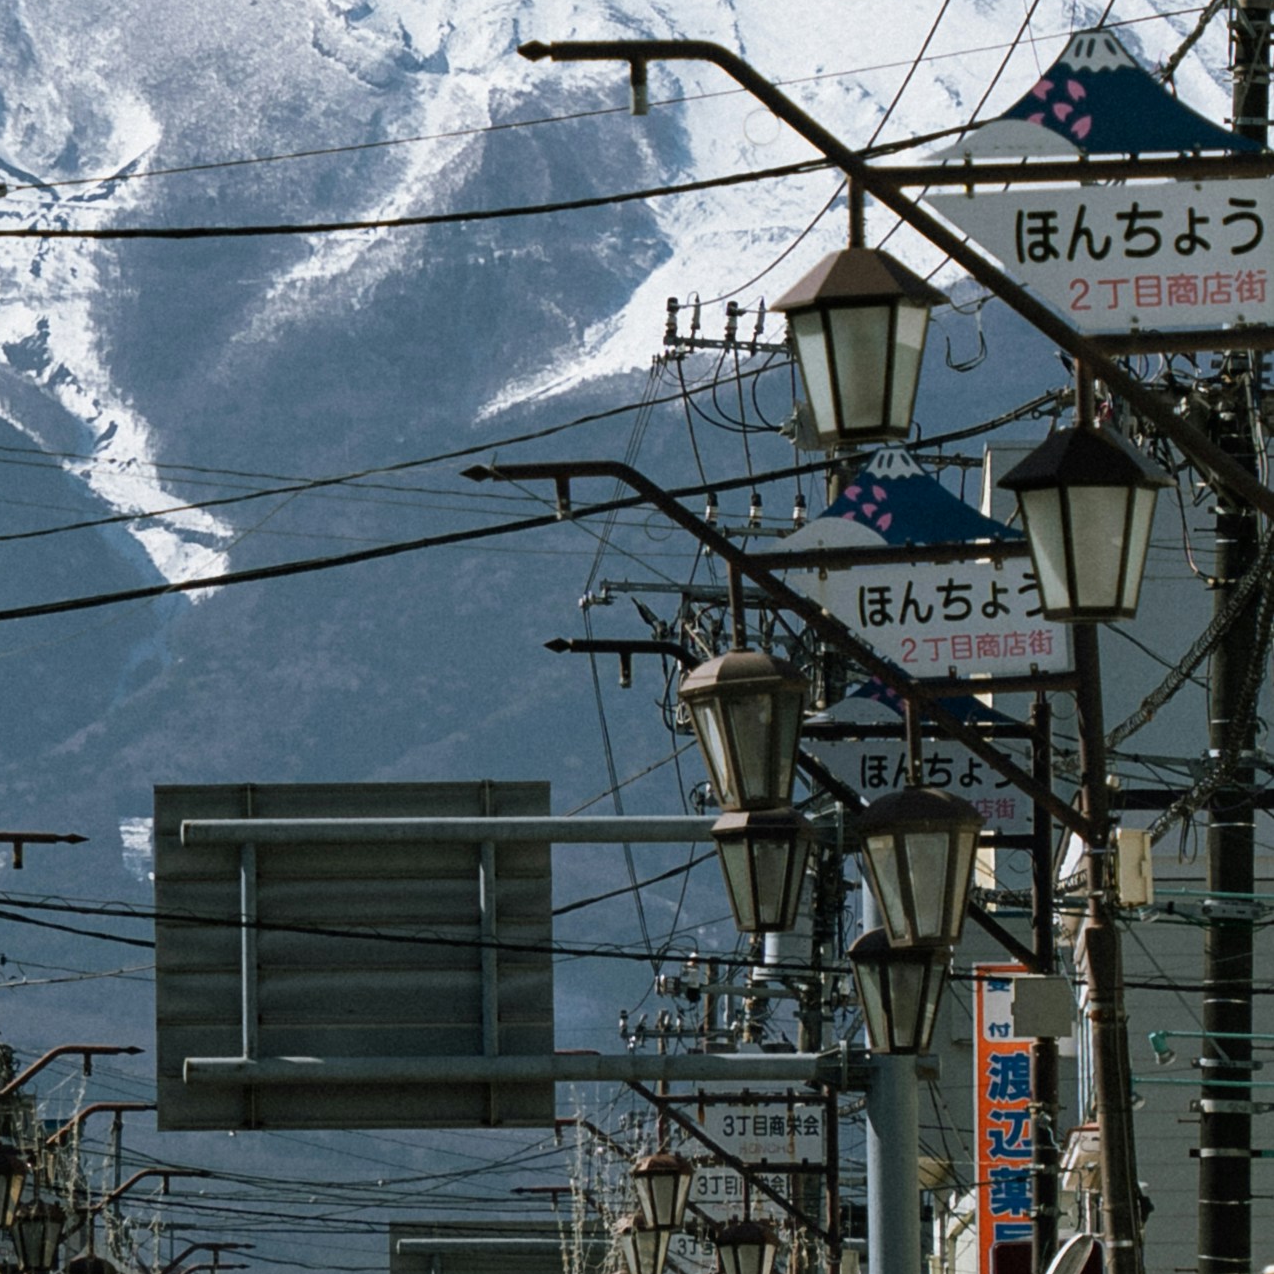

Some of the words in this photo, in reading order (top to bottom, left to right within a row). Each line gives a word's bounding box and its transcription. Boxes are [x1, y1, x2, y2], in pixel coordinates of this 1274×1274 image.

[1016, 197, 1263, 263] ほんちょう
[1069, 269, 1268, 311] 2丁目商店街
[901, 629, 1053, 663] 2丁目商店街
[723, 1115, 819, 1136] 3丁目商栄会
